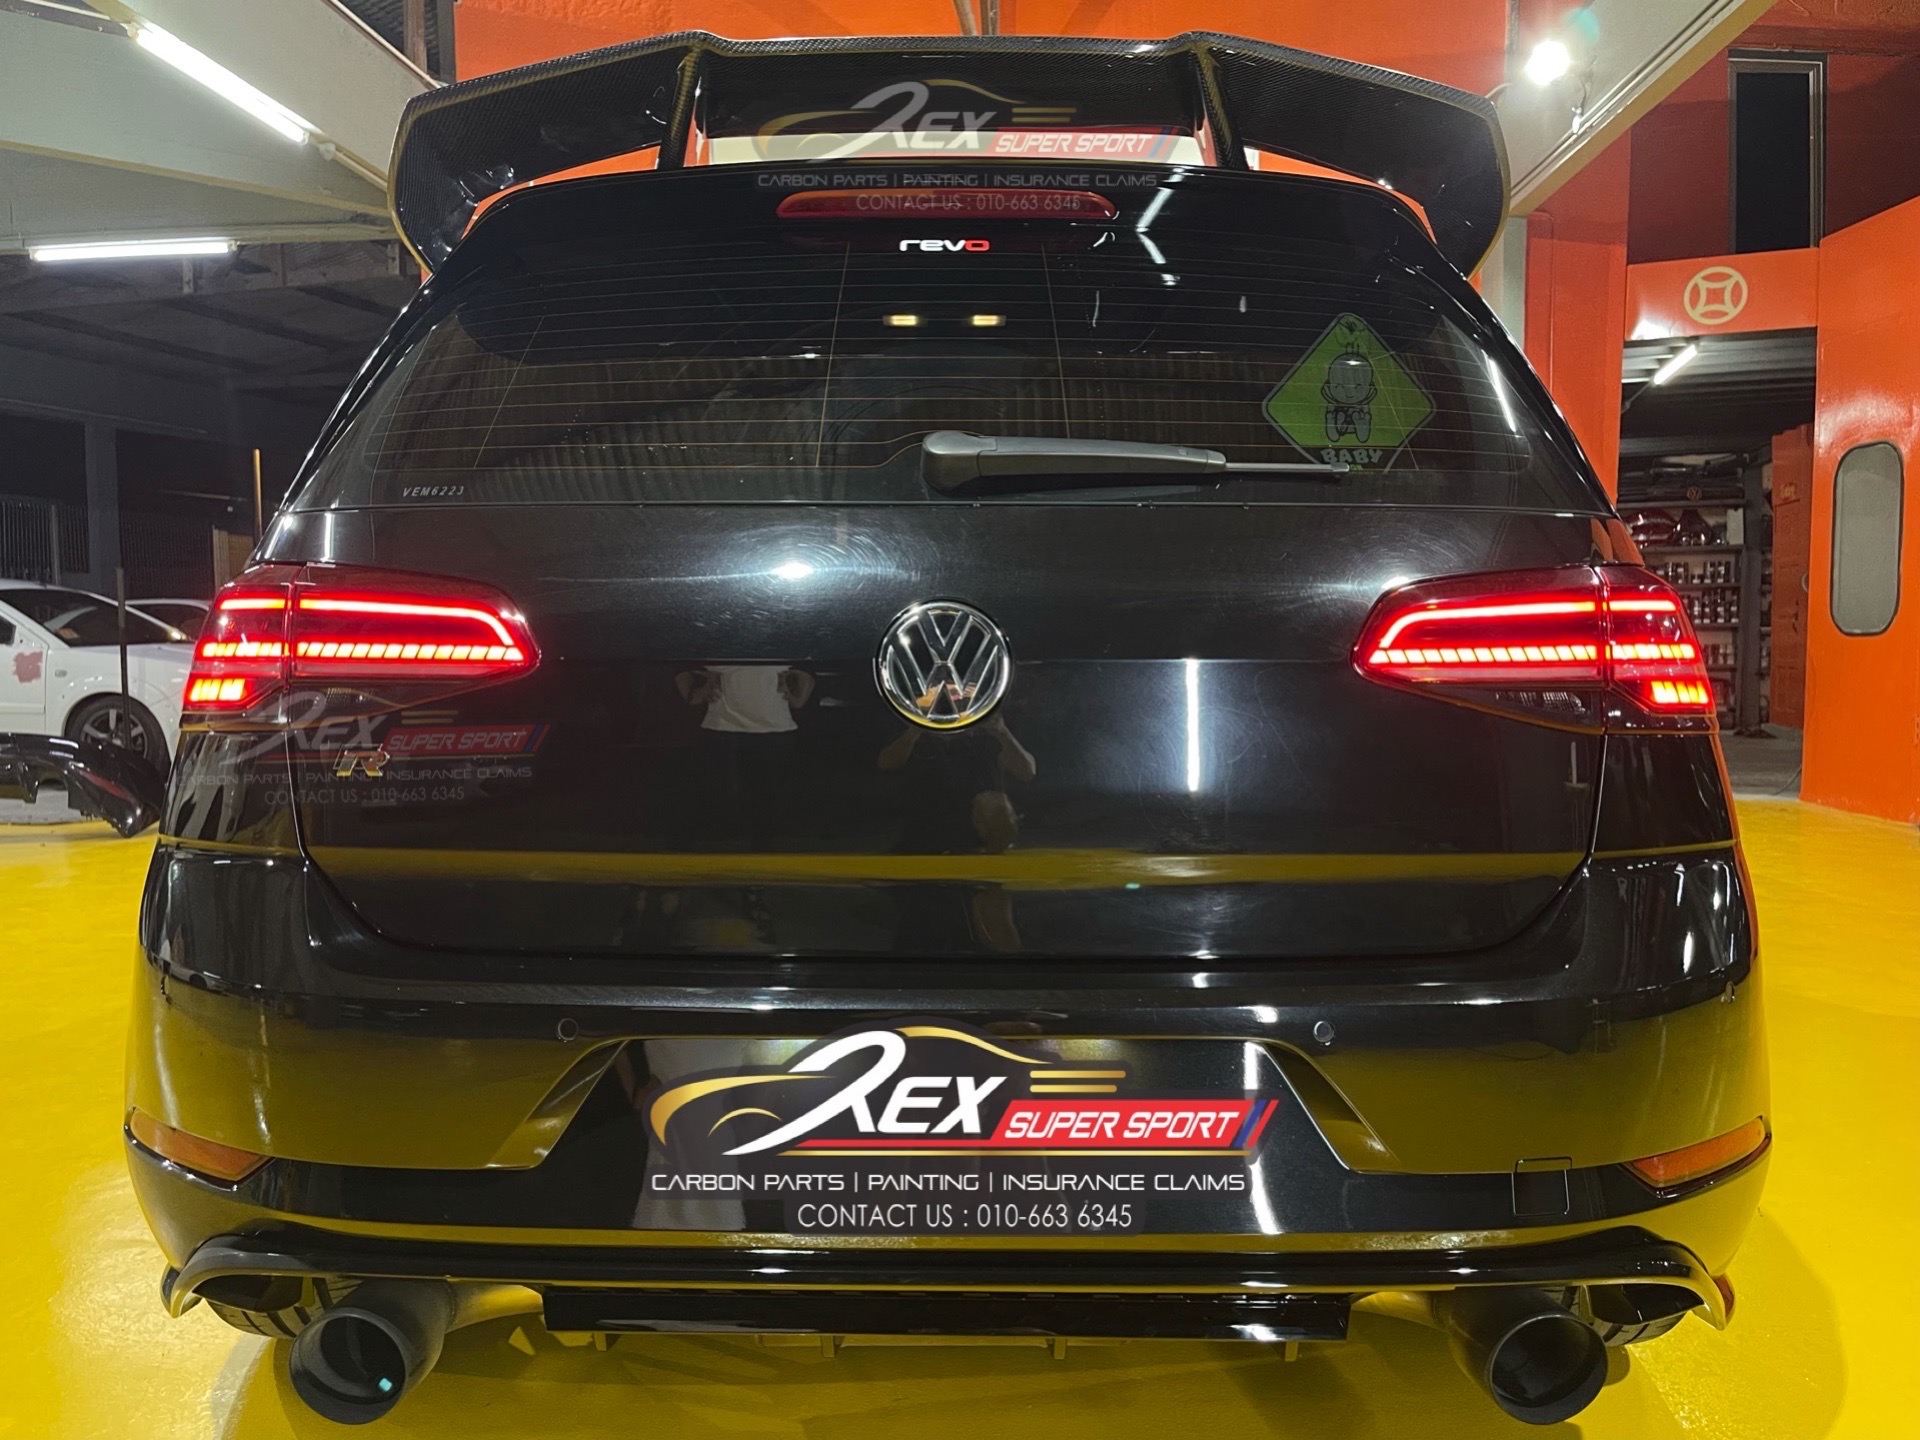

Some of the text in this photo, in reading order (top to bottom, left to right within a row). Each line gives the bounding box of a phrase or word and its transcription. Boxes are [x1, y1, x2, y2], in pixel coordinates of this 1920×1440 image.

[900, 239, 990, 251] revo
[1320, 448, 1383, 463] BABY
[402, 485, 465, 497] VEM6223
[333, 743, 390, 777] R
